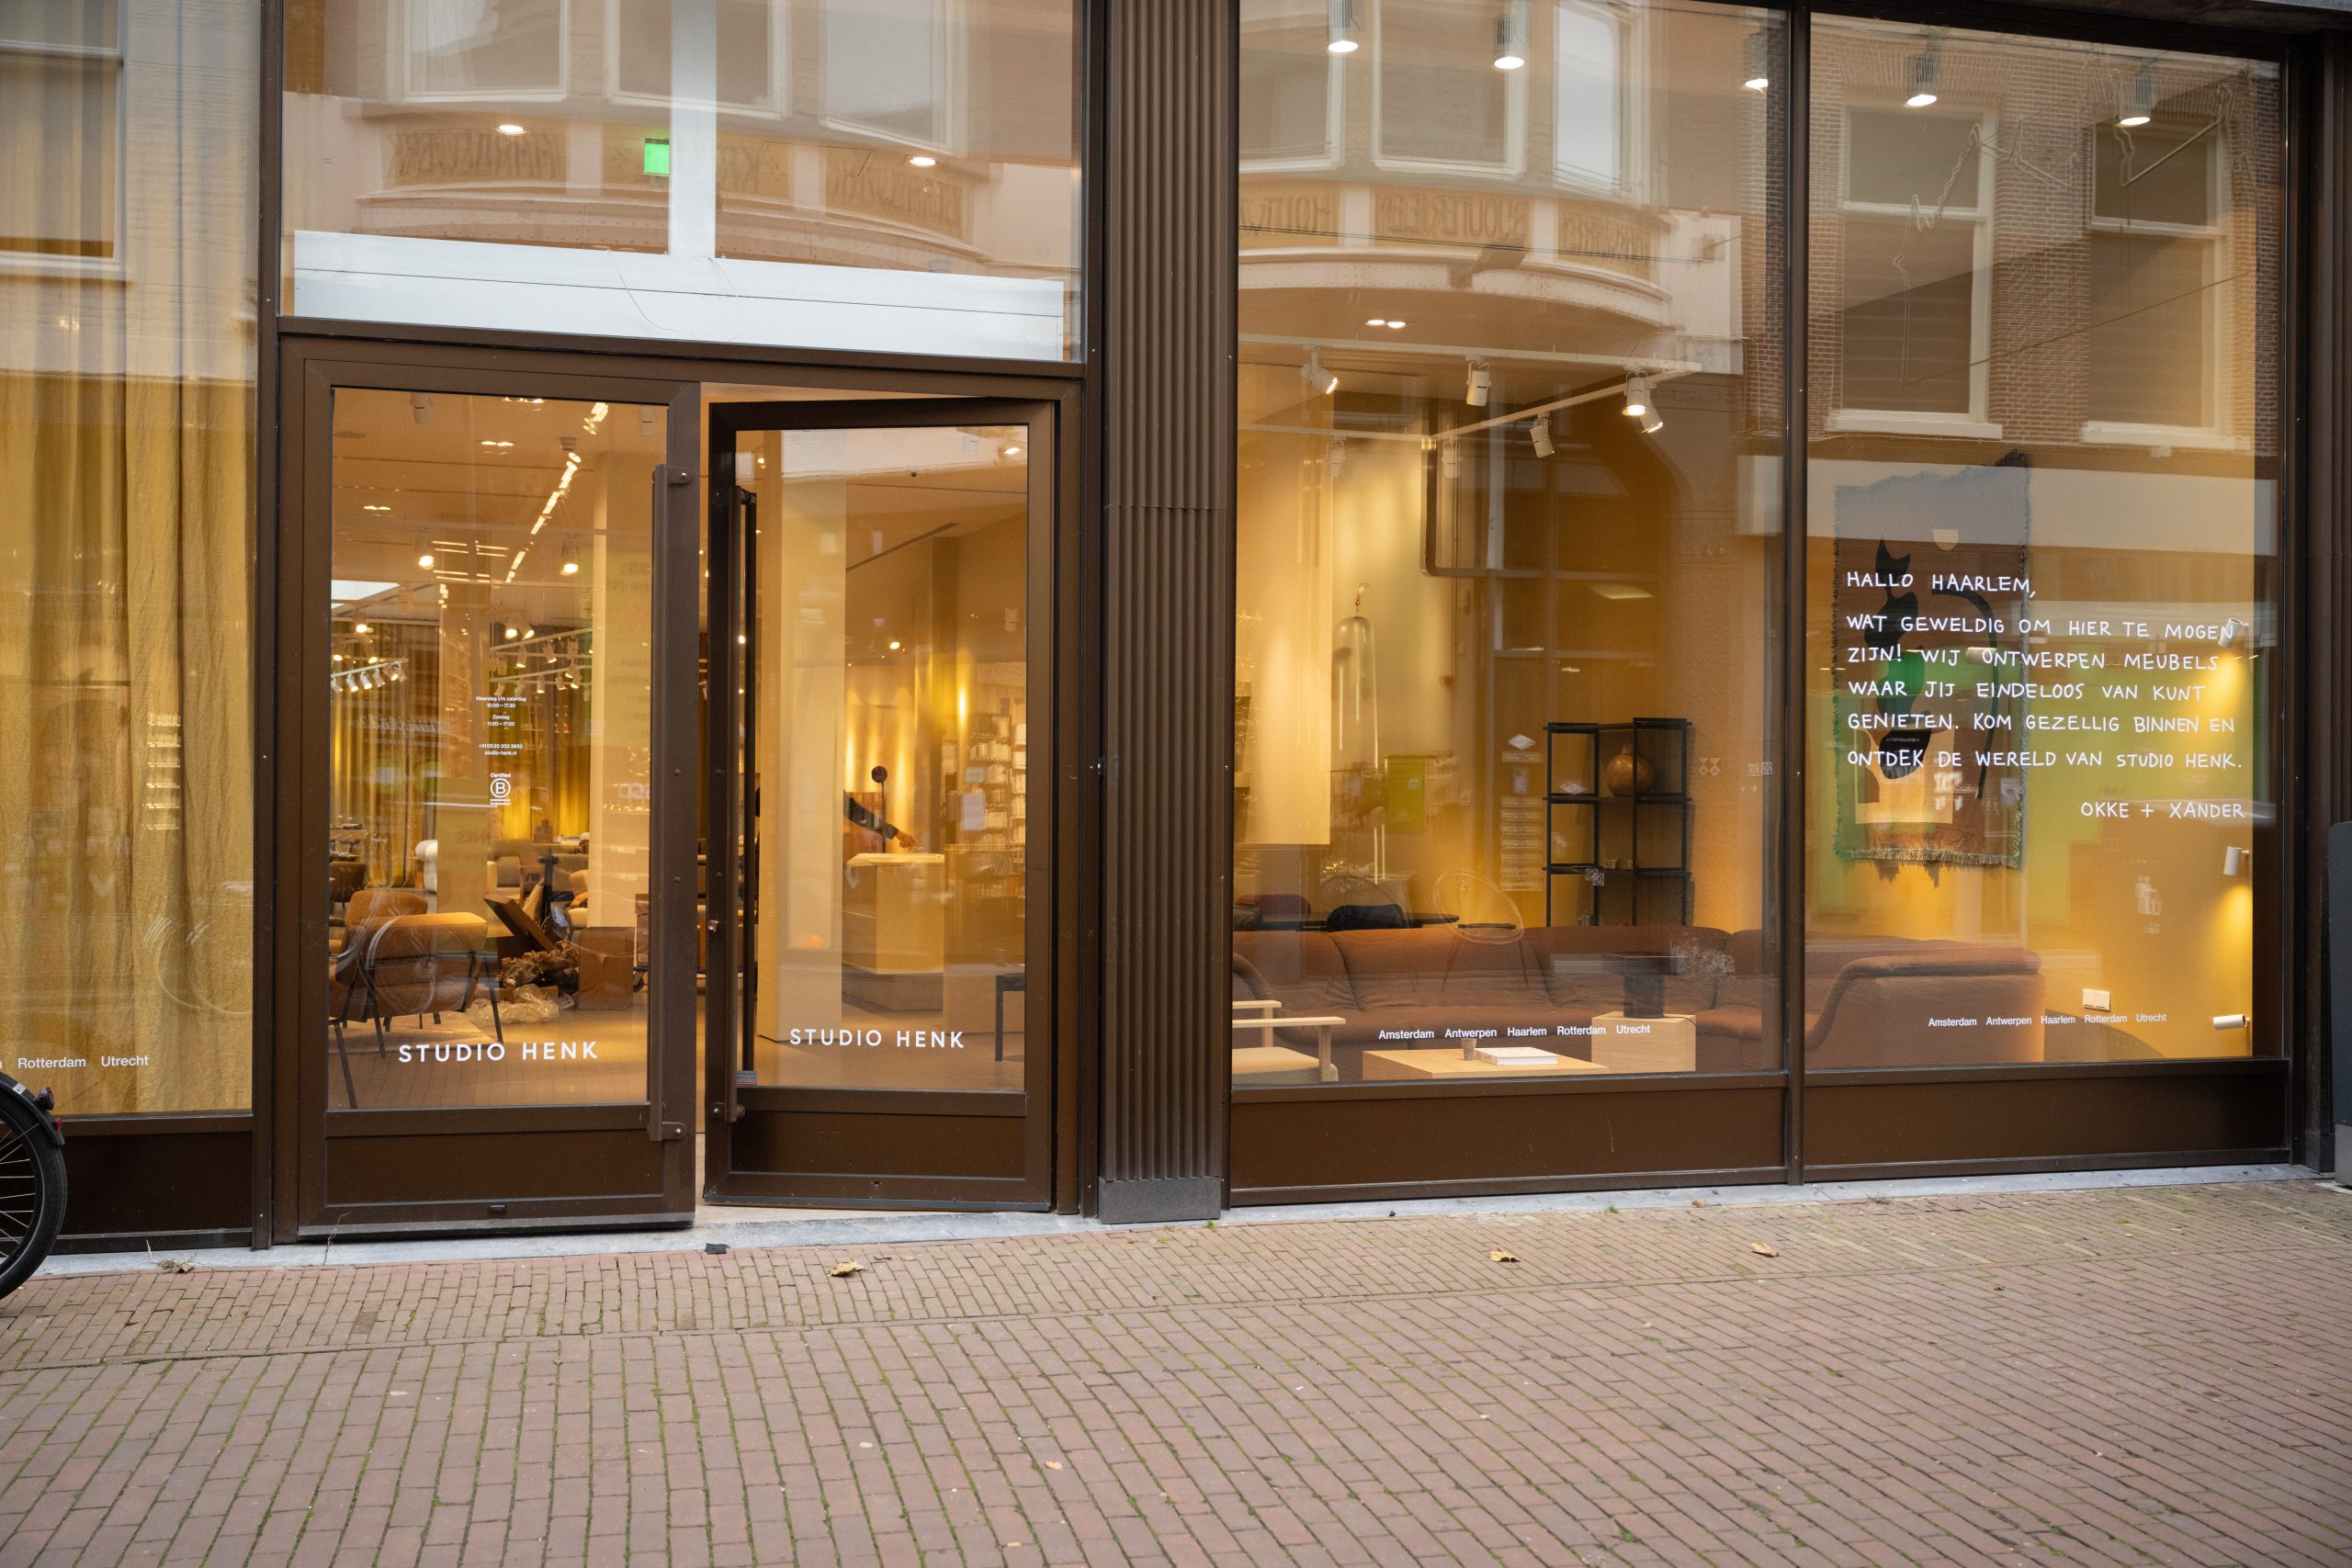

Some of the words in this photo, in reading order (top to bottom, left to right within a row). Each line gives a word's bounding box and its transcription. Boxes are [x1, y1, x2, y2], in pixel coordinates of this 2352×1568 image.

[1848, 571, 1913, 587] HALLO
[1933, 574, 2035, 597] HAARLEM,
[1847, 614, 1887, 631] WAT
[1902, 617, 2004, 633] GEWELDIG
[2019, 619, 2051, 634] OM
[2069, 621, 2111, 636] HIER
[2122, 622, 2149, 637] TE
[2165, 624, 2233, 640] MOGEN
[1849, 644, 1901, 662] ZIJN!
[1921, 650, 1959, 666] WIJ
[1982, 649, 2105, 669] ONTWERPEN
[2125, 654, 2218, 670] MEUBELS
[1849, 681, 1906, 695] WAAR
[1926, 682, 1954, 697] JIJ
[1977, 682, 2084, 699] EINDELOOS
[2102, 685, 2137, 698] VAN
[2154, 686, 2204, 700] KUNT
[1849, 713, 1958, 729] GENIETEN.
[1974, 713, 2011, 730] KOM
[2026, 715, 2119, 731] GEZELLIG
[2134, 716, 2199, 732] BINNEN
[2211, 718, 2233, 731] EN
[1848, 750, 1924, 767] ONTDEK
[1938, 751, 1962, 767] DE
[1975, 751, 2056, 766] WERELD
[2066, 752, 2101, 765] VAN
[2117, 753, 2173, 767] STUDIO
[2186, 753, 2241, 768] HENK.
[2081, 802, 2129, 818] OKKE
[2142, 804, 2154, 817] +
[2170, 801, 2245, 818] XANDER
[1928, 1017, 1977, 1027] Amsterdam
[1986, 1016, 2031, 1027] Antwerpen
[2041, 1015, 2075, 1024] Haarlem
[2084, 1014, 2127, 1024] Rotterdam
[2136, 1013, 2167, 1022] Utrecht
[785, 1028, 882, 1046] STUDIO
[897, 1030, 964, 1049] HENK
[1378, 1029, 1434, 1040] Amsterdam
[1444, 1028, 1497, 1039] Antwerpen
[1507, 1027, 1547, 1037] Haarlem
[1557, 1025, 1606, 1036] Rotterdam
[1616, 1024, 1651, 1034] Utrecht
[398, 1043, 505, 1063] STUDIO
[522, 1041, 598, 1060] HENK
[17, 1057, 86, 1069] Rotterdam
[101, 1055, 149, 1066] Utrecht
